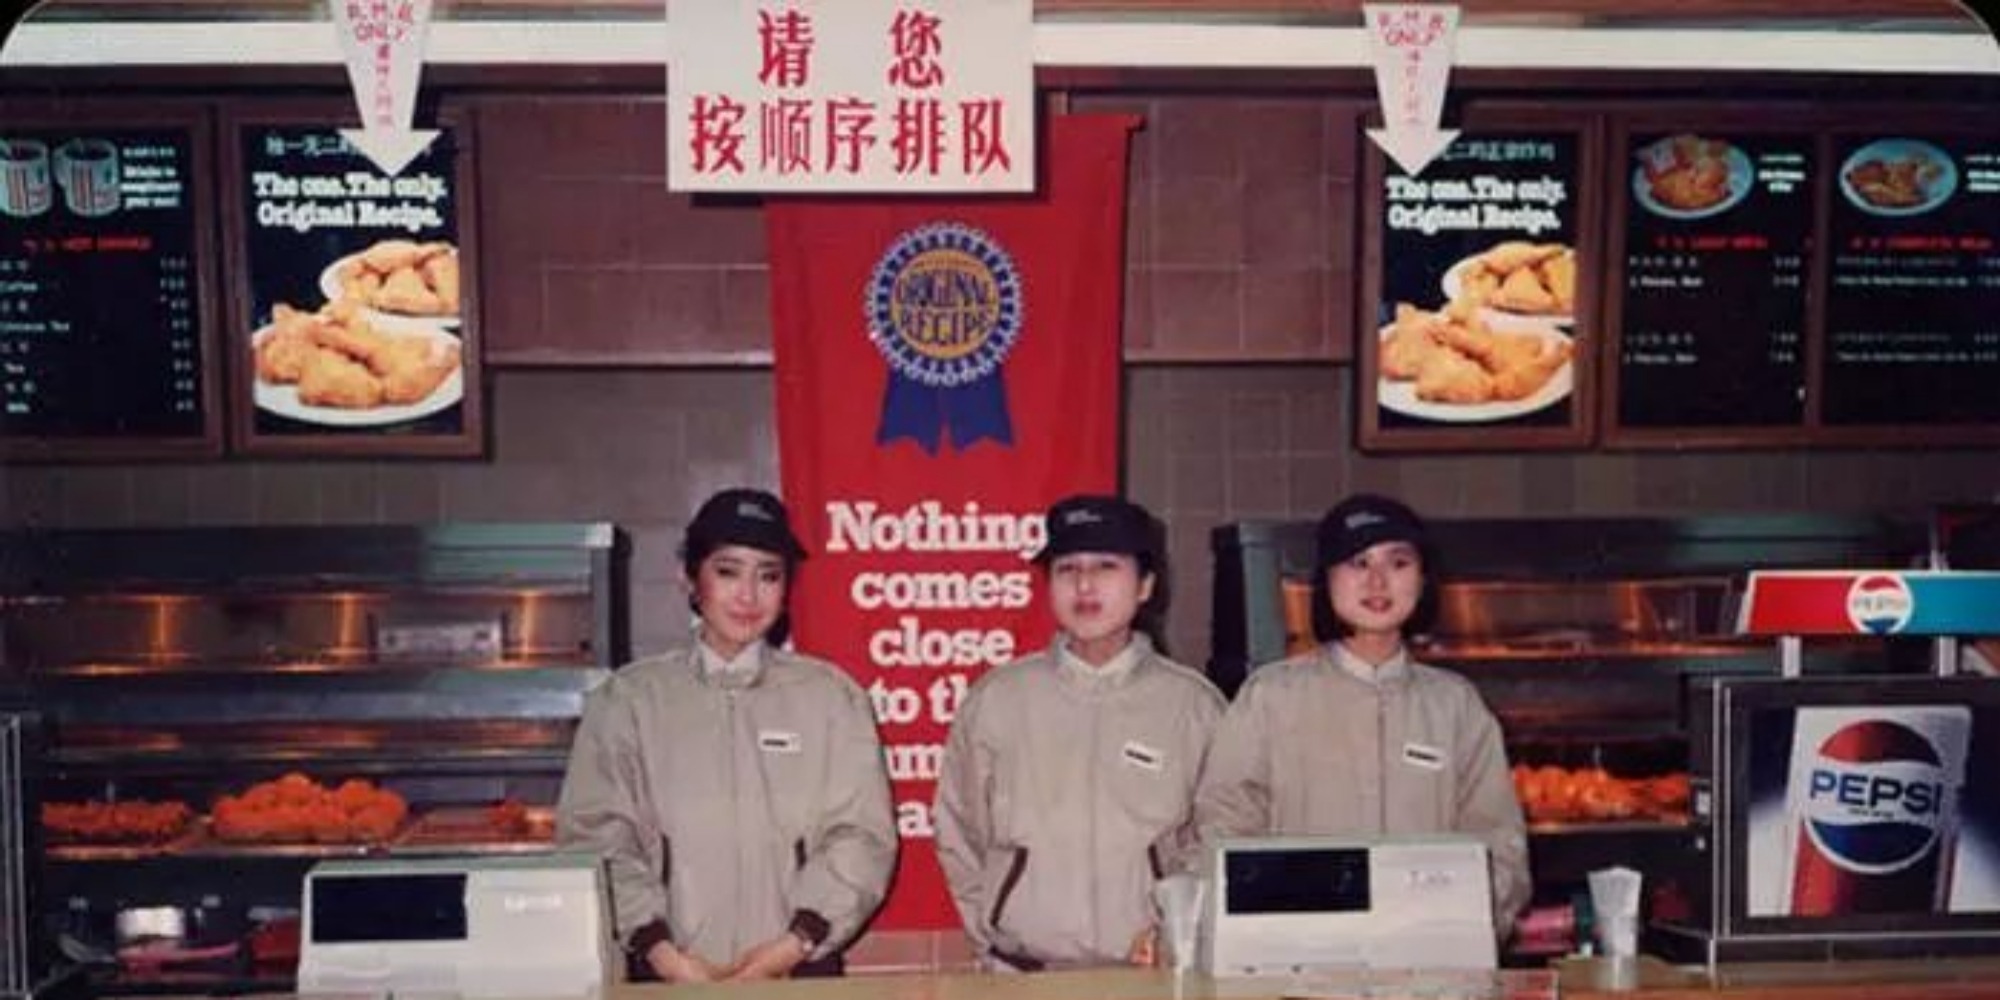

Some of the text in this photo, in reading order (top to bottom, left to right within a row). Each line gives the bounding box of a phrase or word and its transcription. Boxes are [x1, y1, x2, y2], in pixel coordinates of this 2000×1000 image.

[757, 9, 945, 89] 请您
[688, 95, 1012, 175] 按顺序排队
[252, 171, 299, 197] The
[345, 171, 391, 197] The
[1386, 176, 1428, 200] The
[257, 201, 443, 233] Original Recipe.
[1388, 204, 1561, 235] Original Recipe.
[826, 501, 1049, 560] Nothing
[851, 570, 1033, 610] comes
[869, 616, 1015, 665] close
[869, 676, 920, 723] to
[1810, 769, 1943, 816] PEPSI
